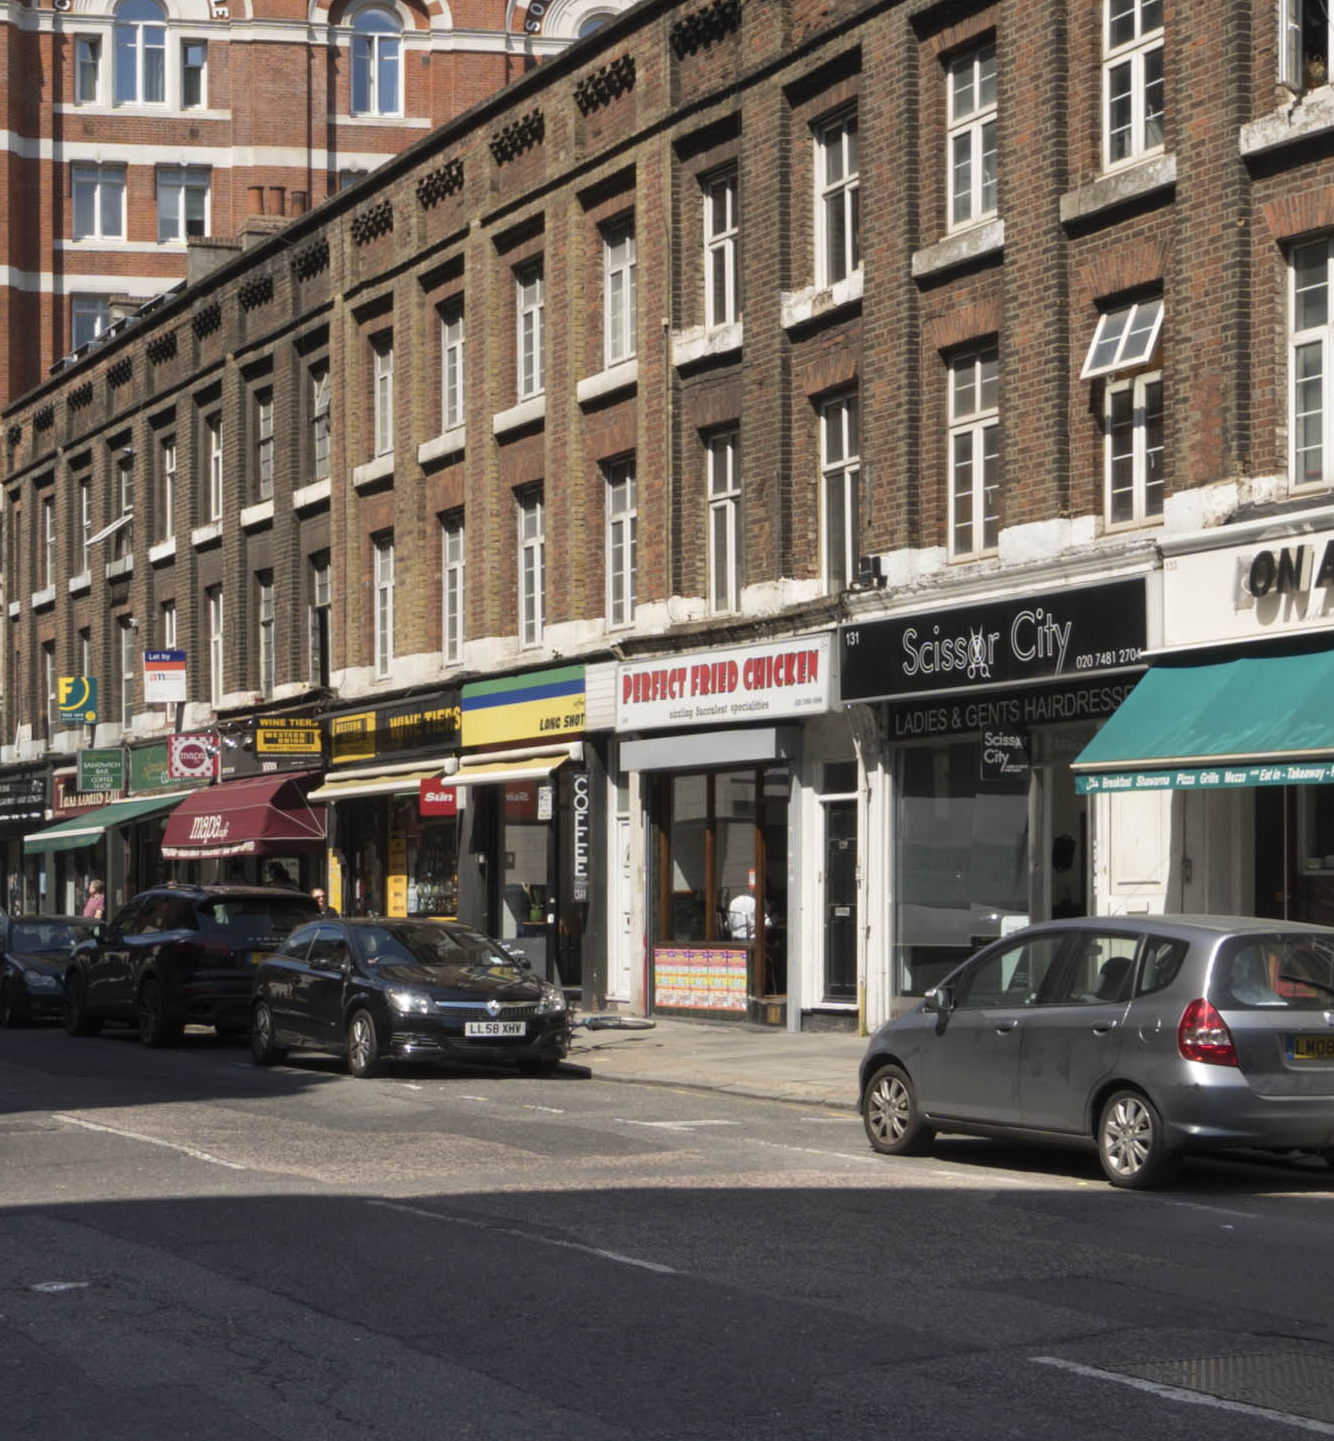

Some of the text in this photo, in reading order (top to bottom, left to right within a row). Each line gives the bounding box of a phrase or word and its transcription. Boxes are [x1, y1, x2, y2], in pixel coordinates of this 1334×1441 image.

[845, 631, 859, 646] 131
[902, 608, 1072, 678] Scissor City
[148, 653, 171, 661] Let by
[1076, 647, 1142, 669] 020 7481 2704
[622, 648, 820, 705] PERFECT FRIED CHICKEN
[669, 708, 693, 720] sizzling
[730, 700, 769, 715] specialities
[895, 708, 948, 736] LADIES
[952, 706, 962, 728] &
[965, 700, 1019, 727] GENTS
[259, 718, 287, 727] WINE
[539, 713, 585, 732] LONG SHOT
[179, 751, 206, 762] mapa
[983, 748, 1010, 773] City
[1102, 777, 1132, 789] Breakfast
[1136, 775, 1170, 787] Shawarma
[1176, 773, 1196, 785] Pizza
[1199, 772, 1219, 784] Grills
[1259, 768, 1271, 781] Eat
[1272, 768, 1281, 780] in
[1287, 767, 1325, 782] Takeaway
[189, 814, 223, 844] mapa
[573, 776, 589, 877] COFFEE
[470, 1023, 522, 1034] LL58 XHV
